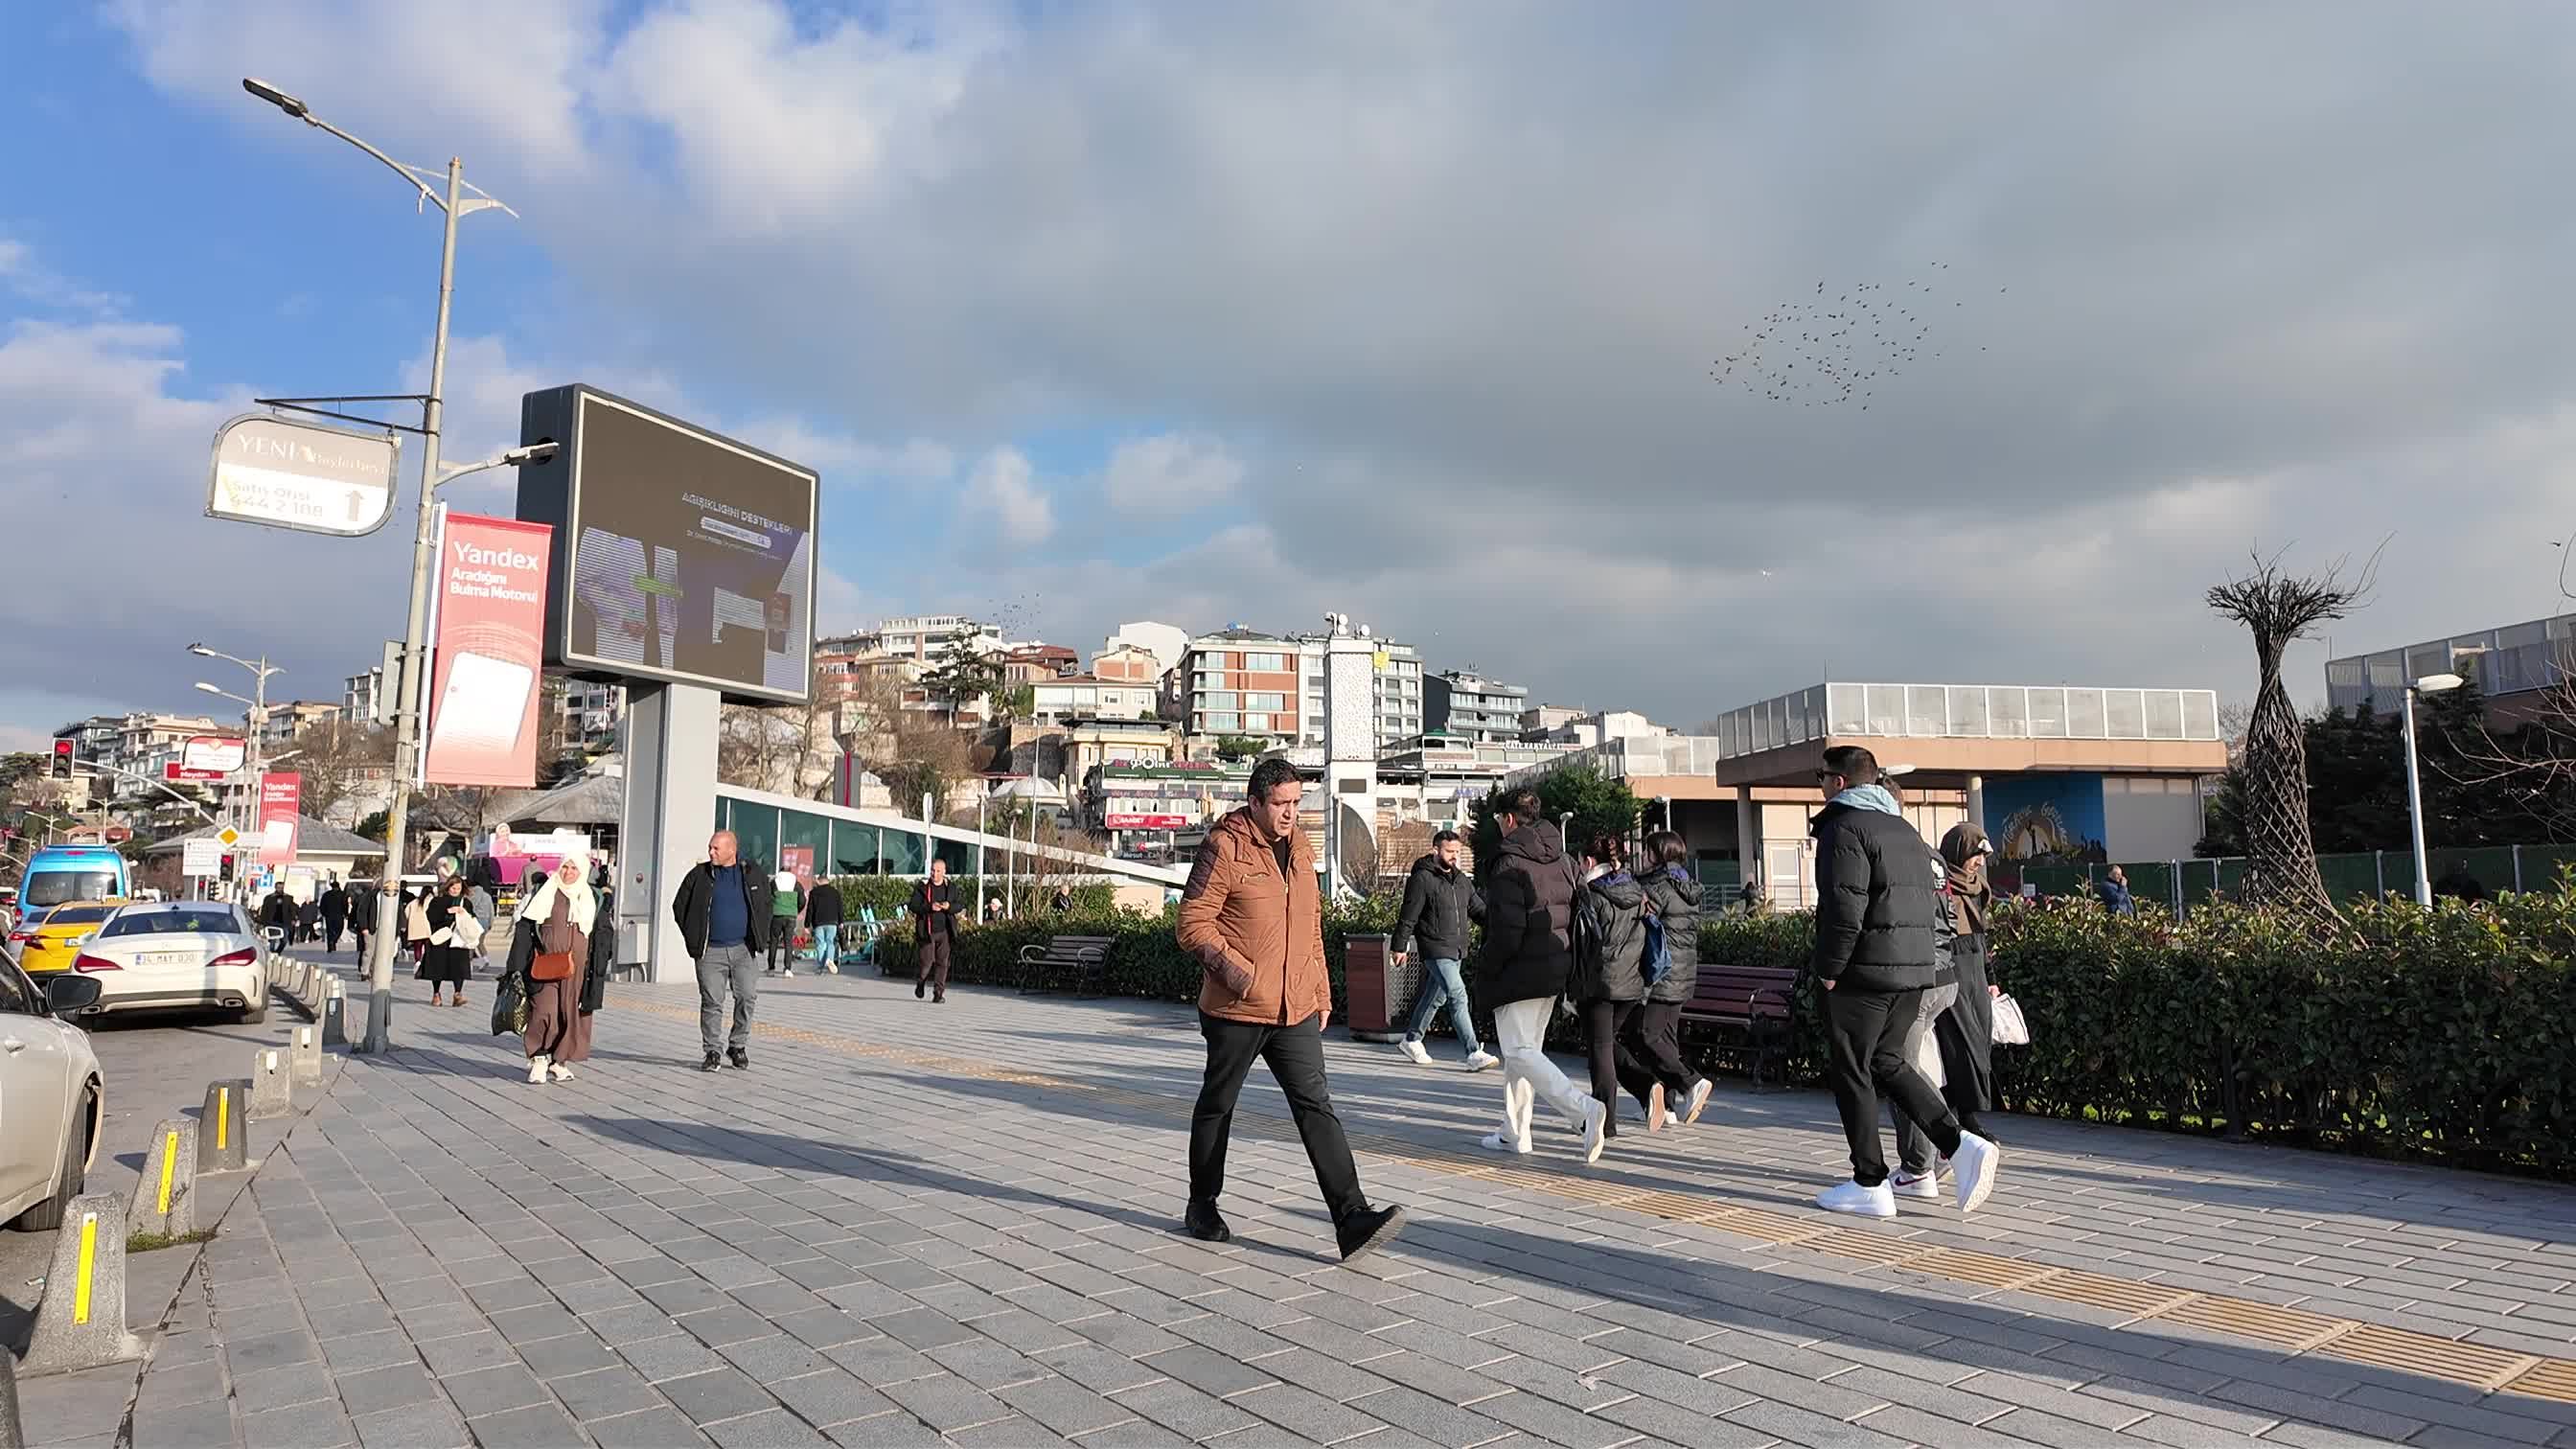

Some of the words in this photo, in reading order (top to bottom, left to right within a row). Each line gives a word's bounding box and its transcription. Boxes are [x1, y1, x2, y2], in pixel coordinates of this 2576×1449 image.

[453, 540, 539, 572] Yandex
[449, 581, 490, 597] Bulma
[264, 782, 296, 792] Yandex
